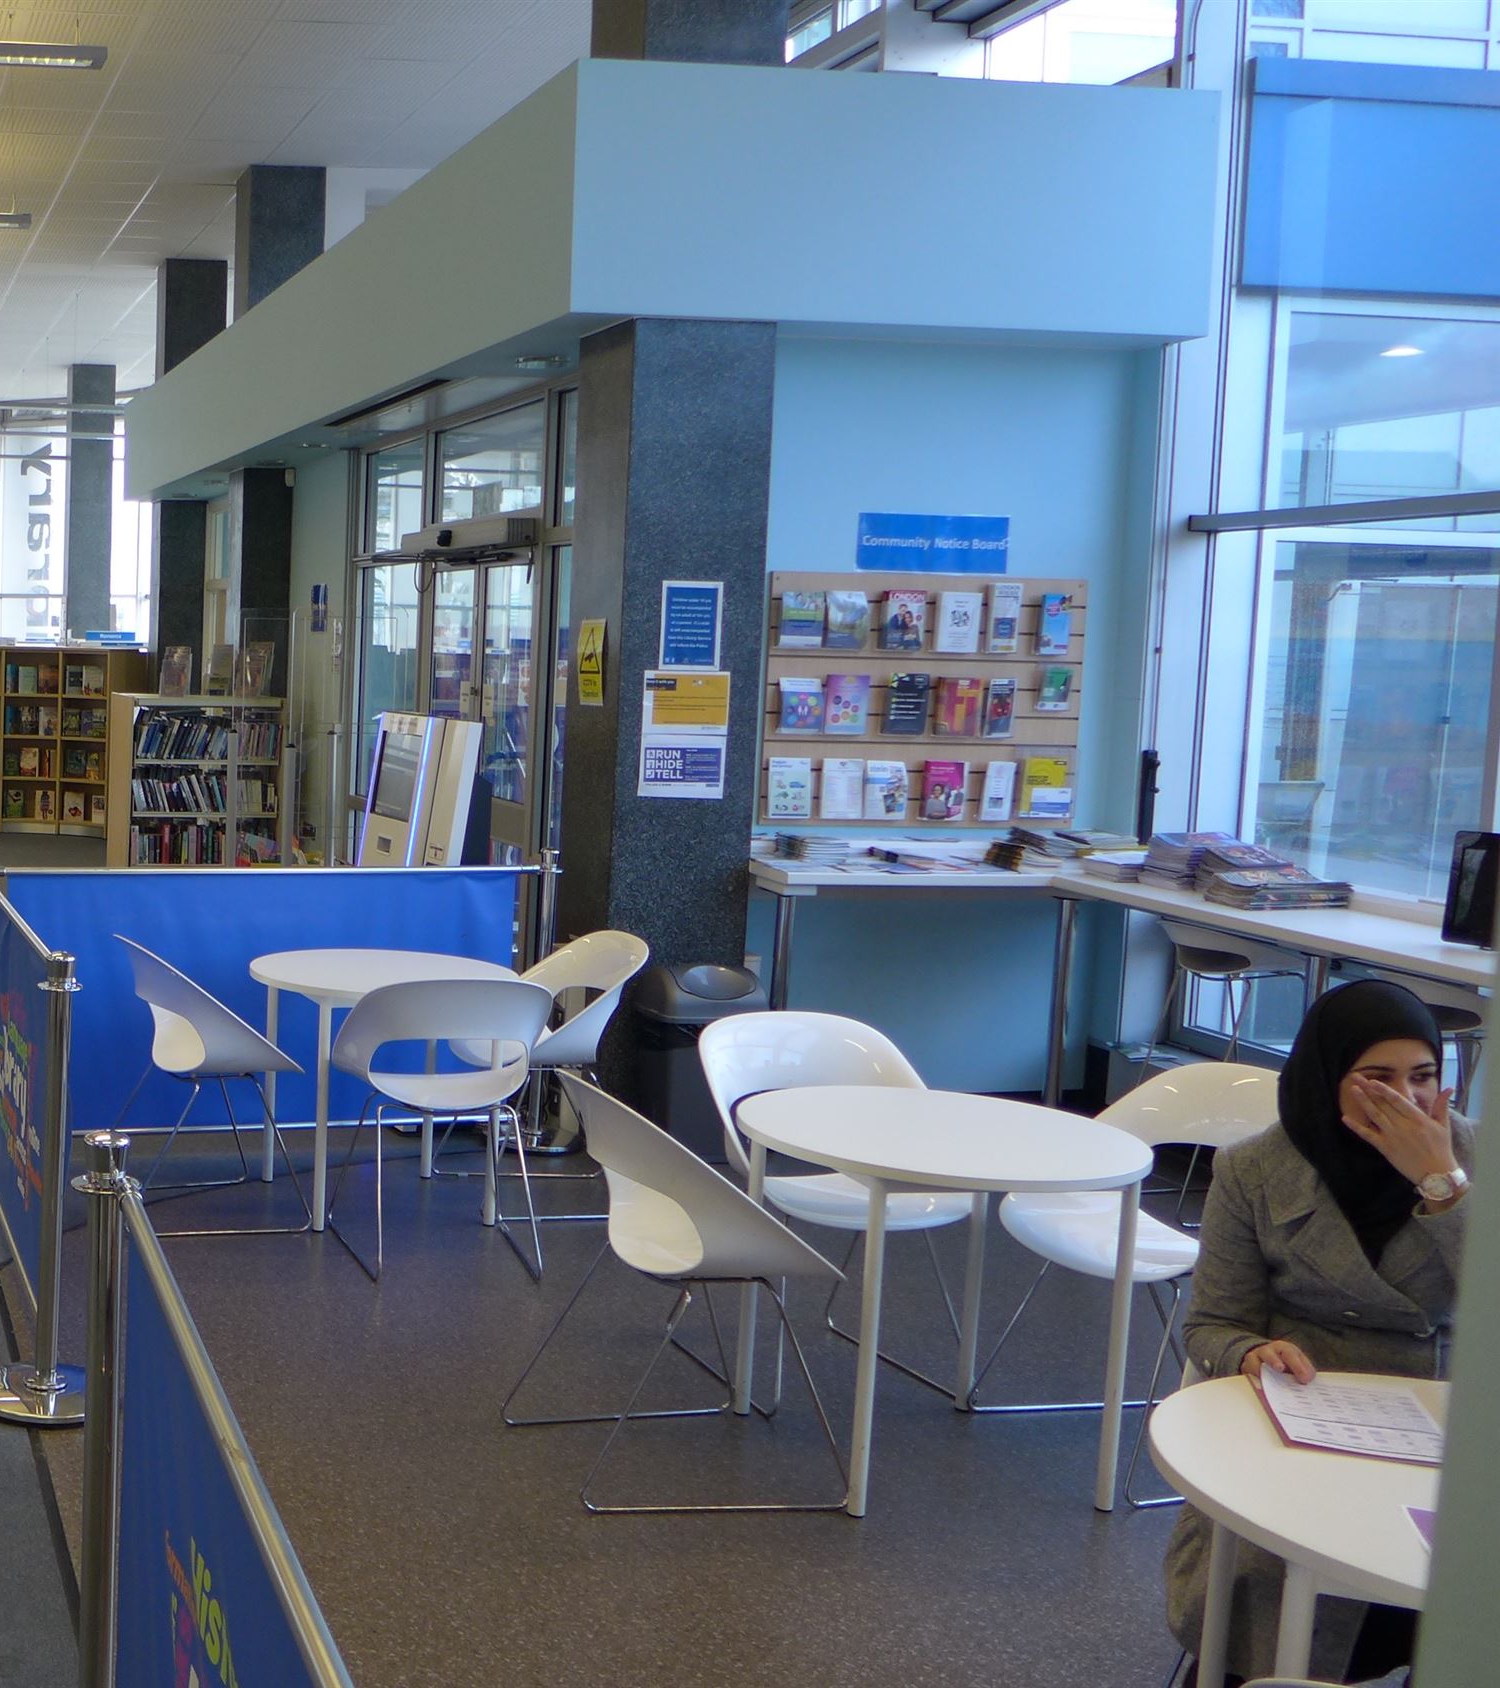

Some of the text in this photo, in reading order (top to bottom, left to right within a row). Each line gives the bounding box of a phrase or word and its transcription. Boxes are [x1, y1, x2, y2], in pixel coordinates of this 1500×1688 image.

[862, 535, 1008, 550] Community Notice Board
[889, 592, 925, 601] LONDON
[656, 750, 681, 759] RUN
[655, 760, 684, 769] HIDE
[656, 769, 684, 779] TELL
